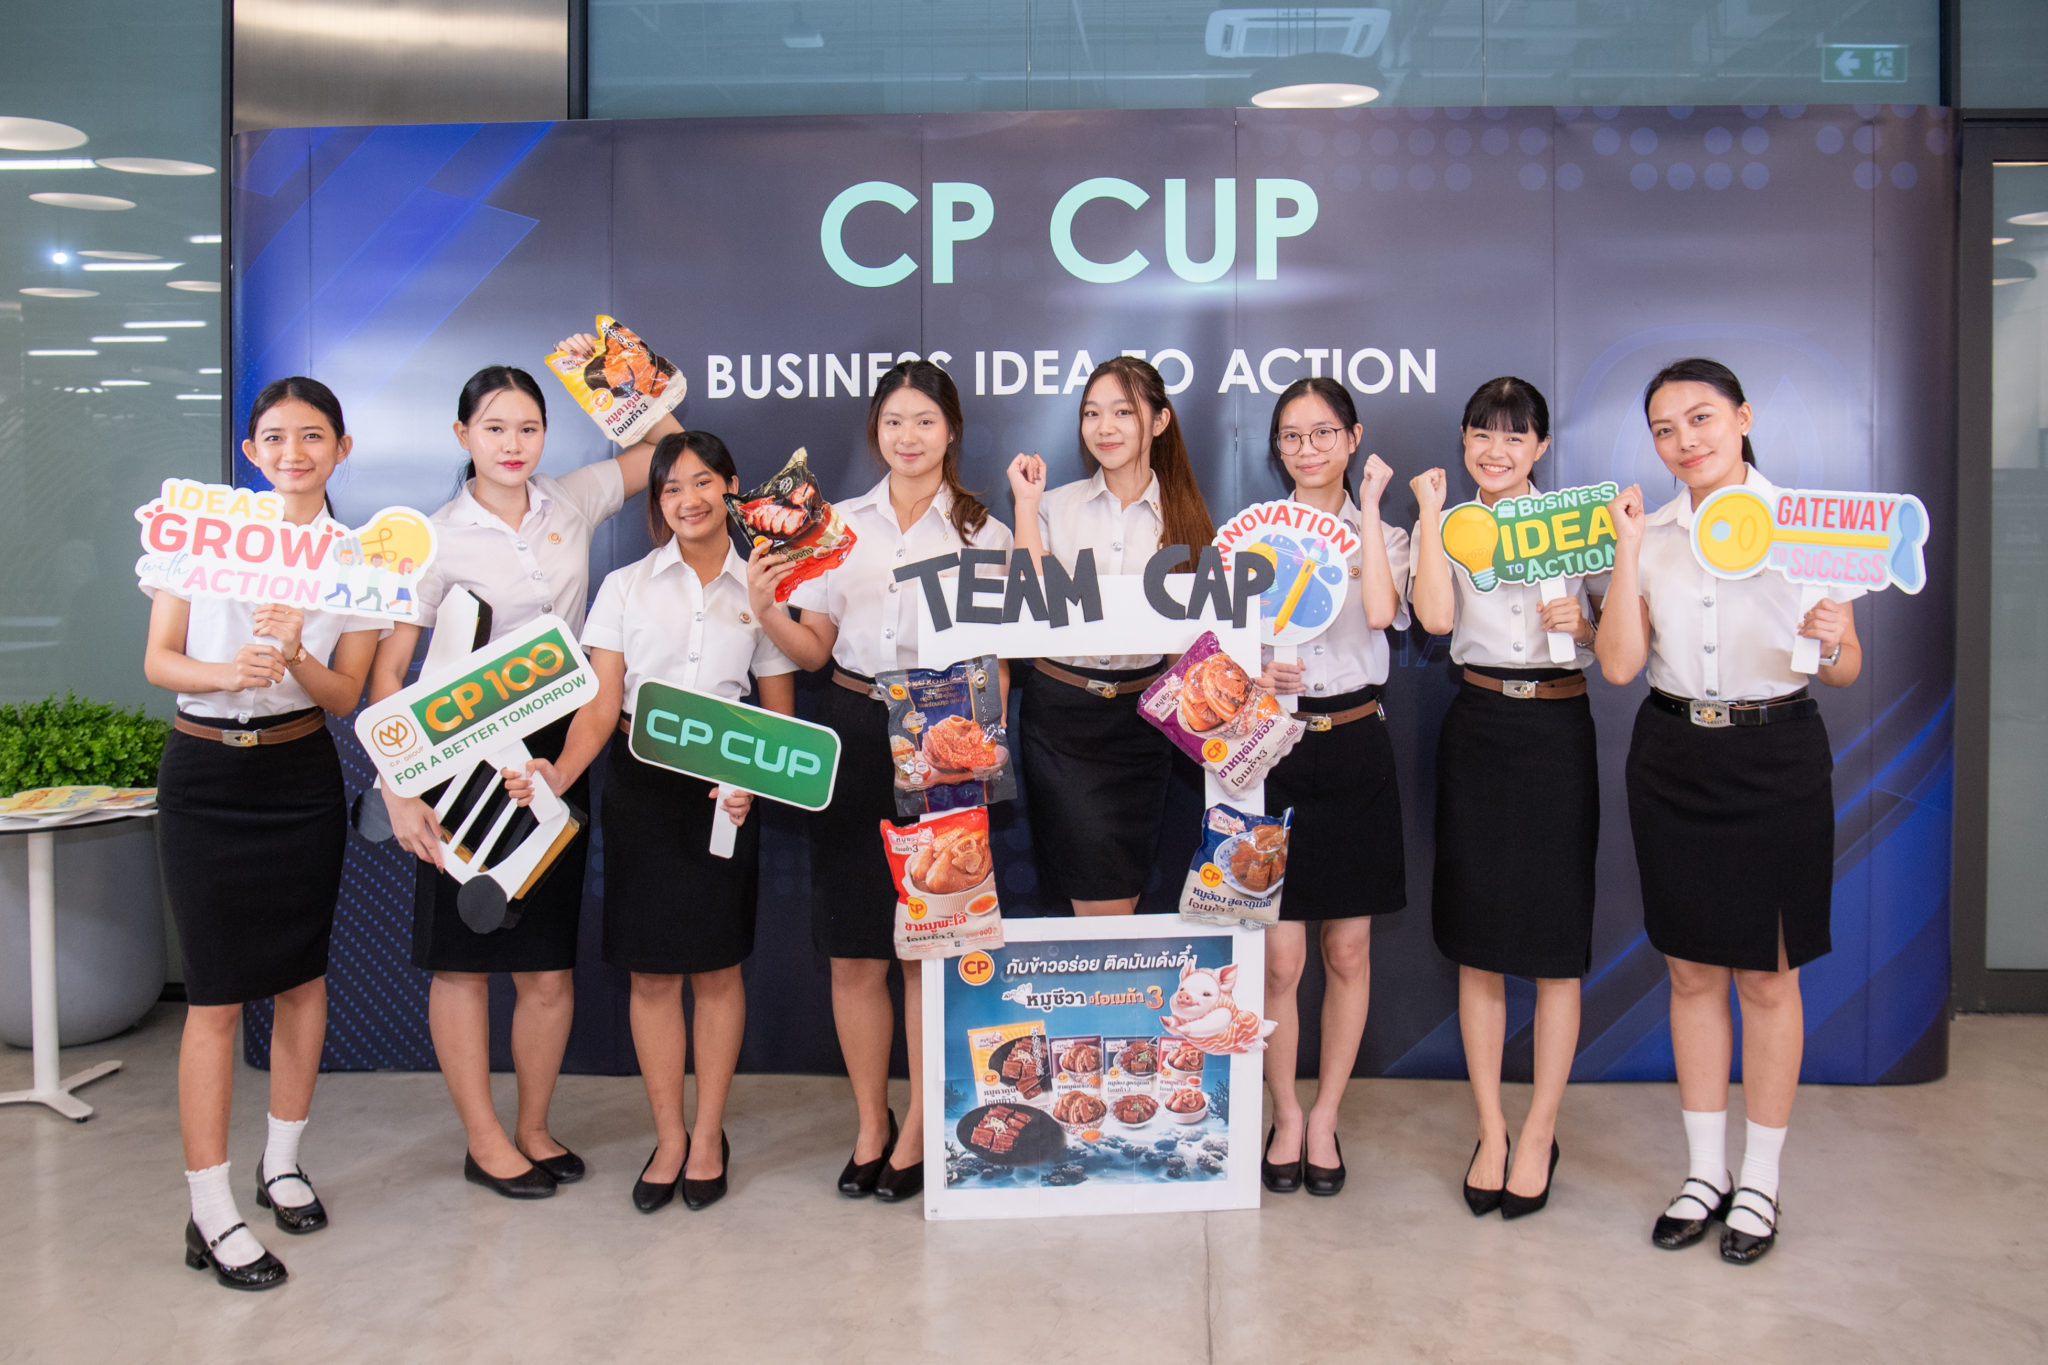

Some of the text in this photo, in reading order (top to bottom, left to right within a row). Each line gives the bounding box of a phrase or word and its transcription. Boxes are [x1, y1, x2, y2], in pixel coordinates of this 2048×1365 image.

[820, 176, 1319, 288] CP CUP
[707, 350, 953, 400] BUSINES
[975, 348, 1096, 396] IDEA
[1218, 346, 1437, 396] ACTION
[168, 484, 278, 521] IDEAS
[1777, 495, 1896, 531] GATEWAY
[149, 512, 333, 570] GROW
[1500, 505, 1618, 561] IDEA
[140, 551, 191, 583] with
[1506, 562, 1525, 576] TO
[1772, 547, 1788, 564] TO
[182, 565, 321, 604] ACTION
[893, 544, 1276, 633] TEAM CAP
[424, 641, 565, 732] CP 100
[394, 673, 588, 786] FOR A BETTER TOMORROW
[645, 708, 822, 778] CP CUP
[1207, 741, 1223, 759] CP
[1259, 748, 1269, 759] 3
[1202, 868, 1221, 882] CP
[905, 911, 968, 933] ขาหมูพะโล้
[963, 959, 989, 975] CP
[1006, 954, 1100, 976] กับข้าวอร่อย
[1026, 986, 1086, 1011] หมูชีวา
[1146, 985, 1165, 1010] 3
[984, 1074, 998, 1082] CP
